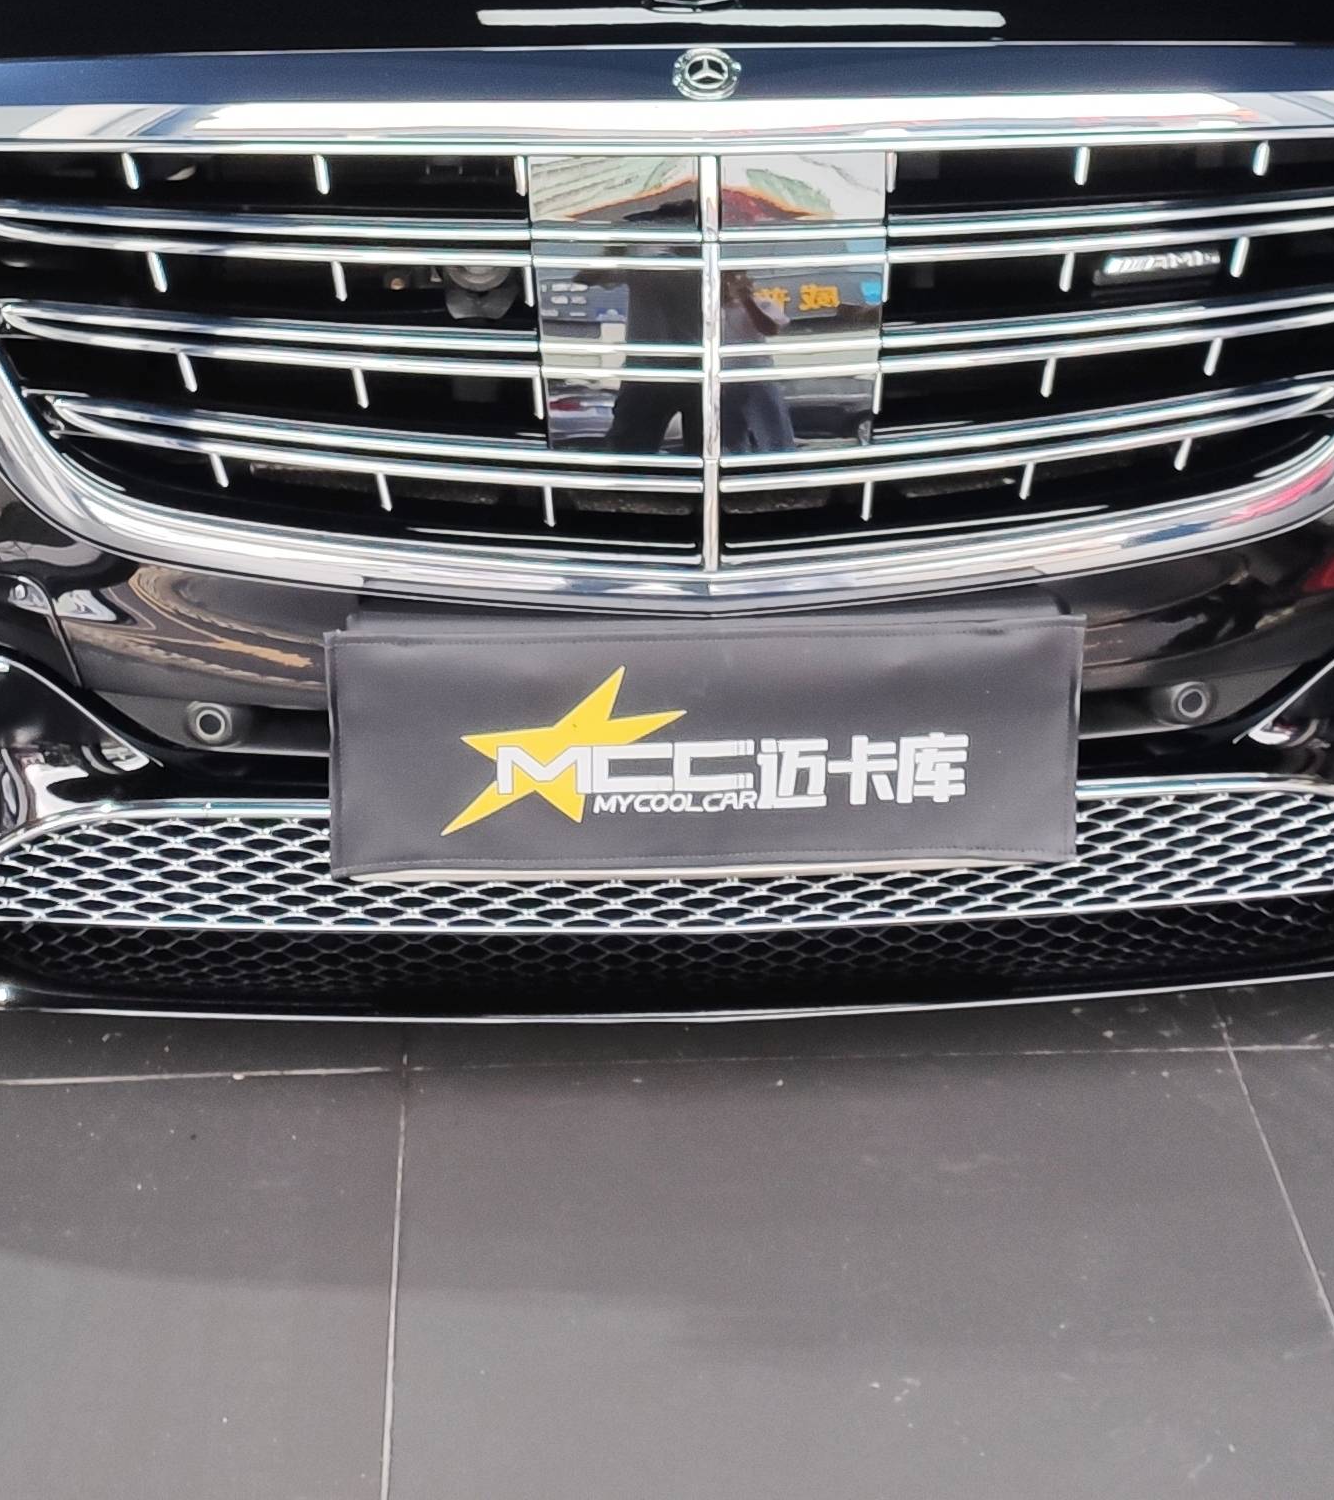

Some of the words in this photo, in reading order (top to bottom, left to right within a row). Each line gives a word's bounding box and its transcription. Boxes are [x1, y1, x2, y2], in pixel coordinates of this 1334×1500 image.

[756, 731, 970, 811] 迈卡库
[592, 790, 757, 814] MYCOOLCAR
